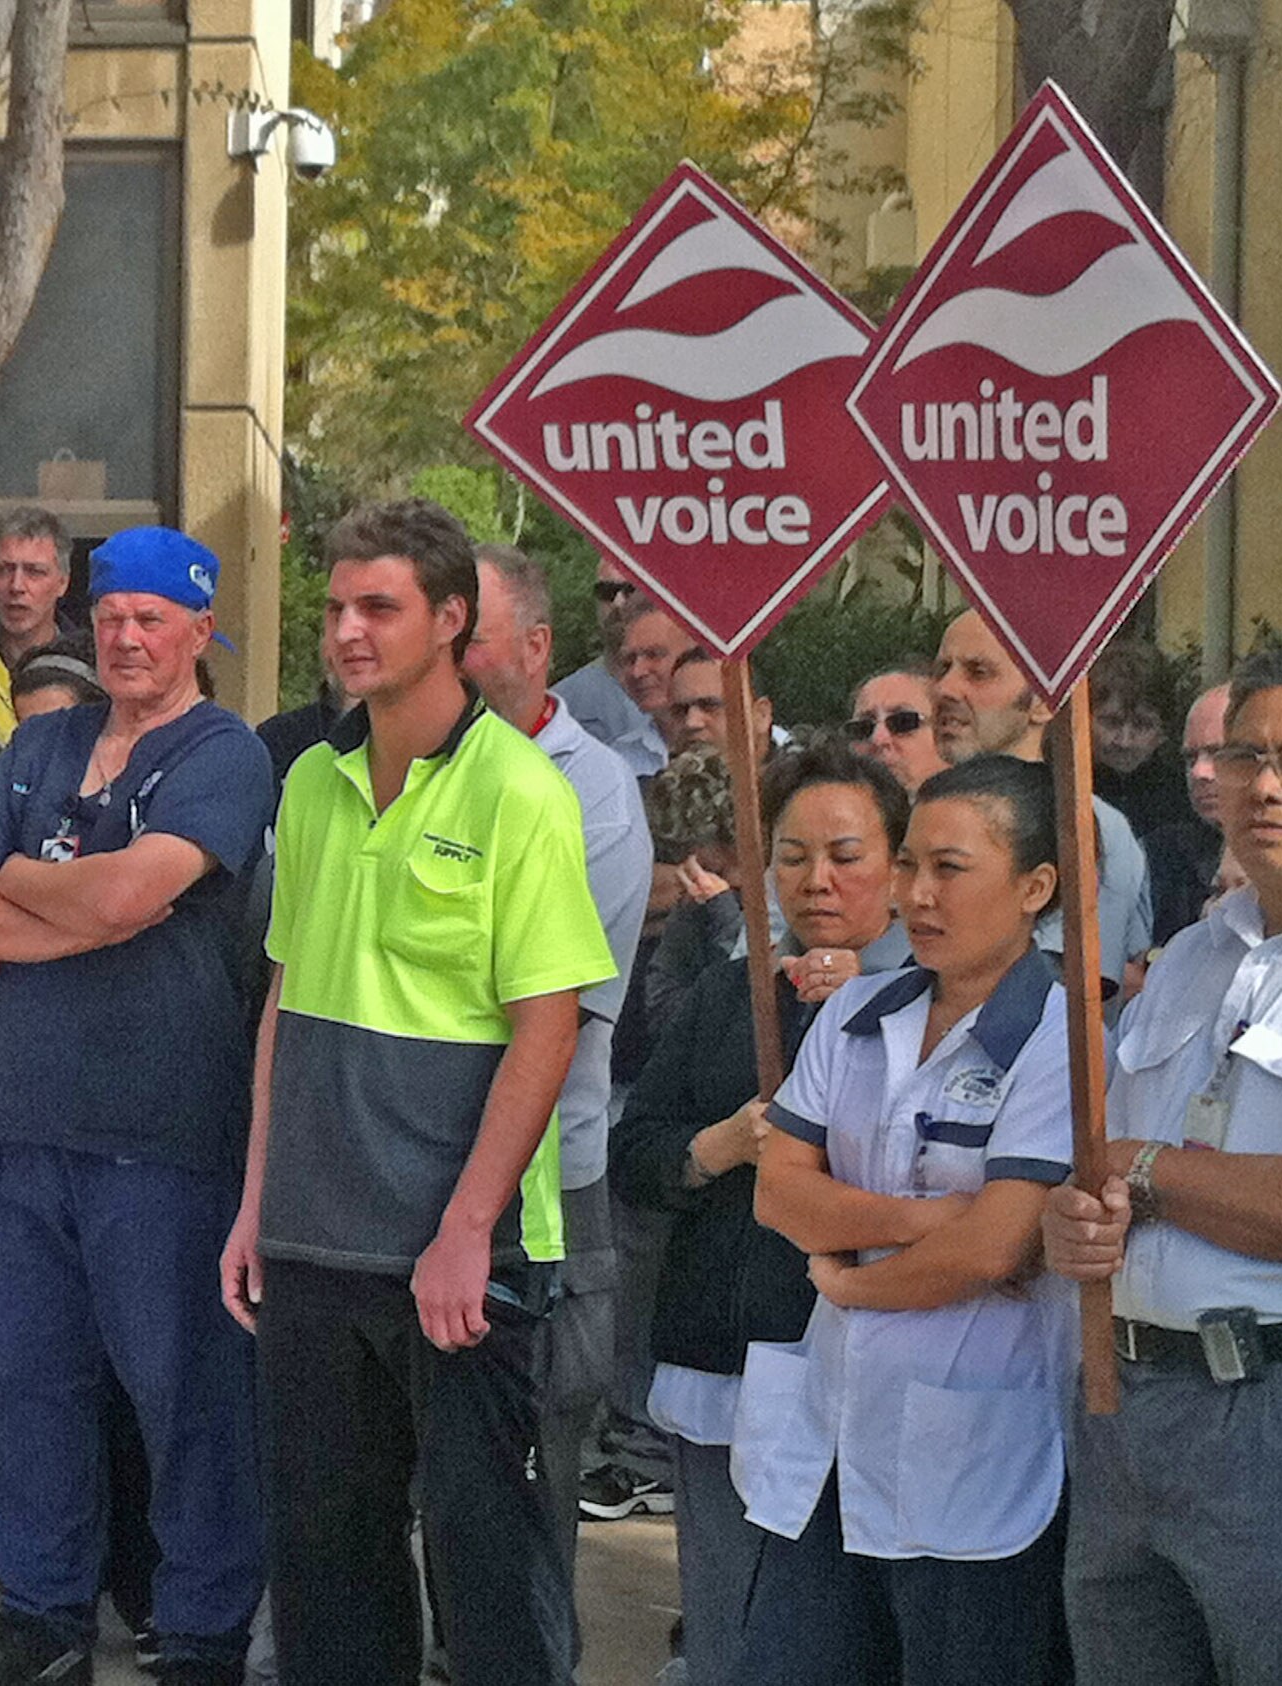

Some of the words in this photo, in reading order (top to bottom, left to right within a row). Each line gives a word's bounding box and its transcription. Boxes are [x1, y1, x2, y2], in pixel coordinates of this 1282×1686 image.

[543, 399, 786, 472] united
[901, 375, 1109, 462] united
[615, 477, 811, 546] voice
[957, 471, 1128, 557] voice
